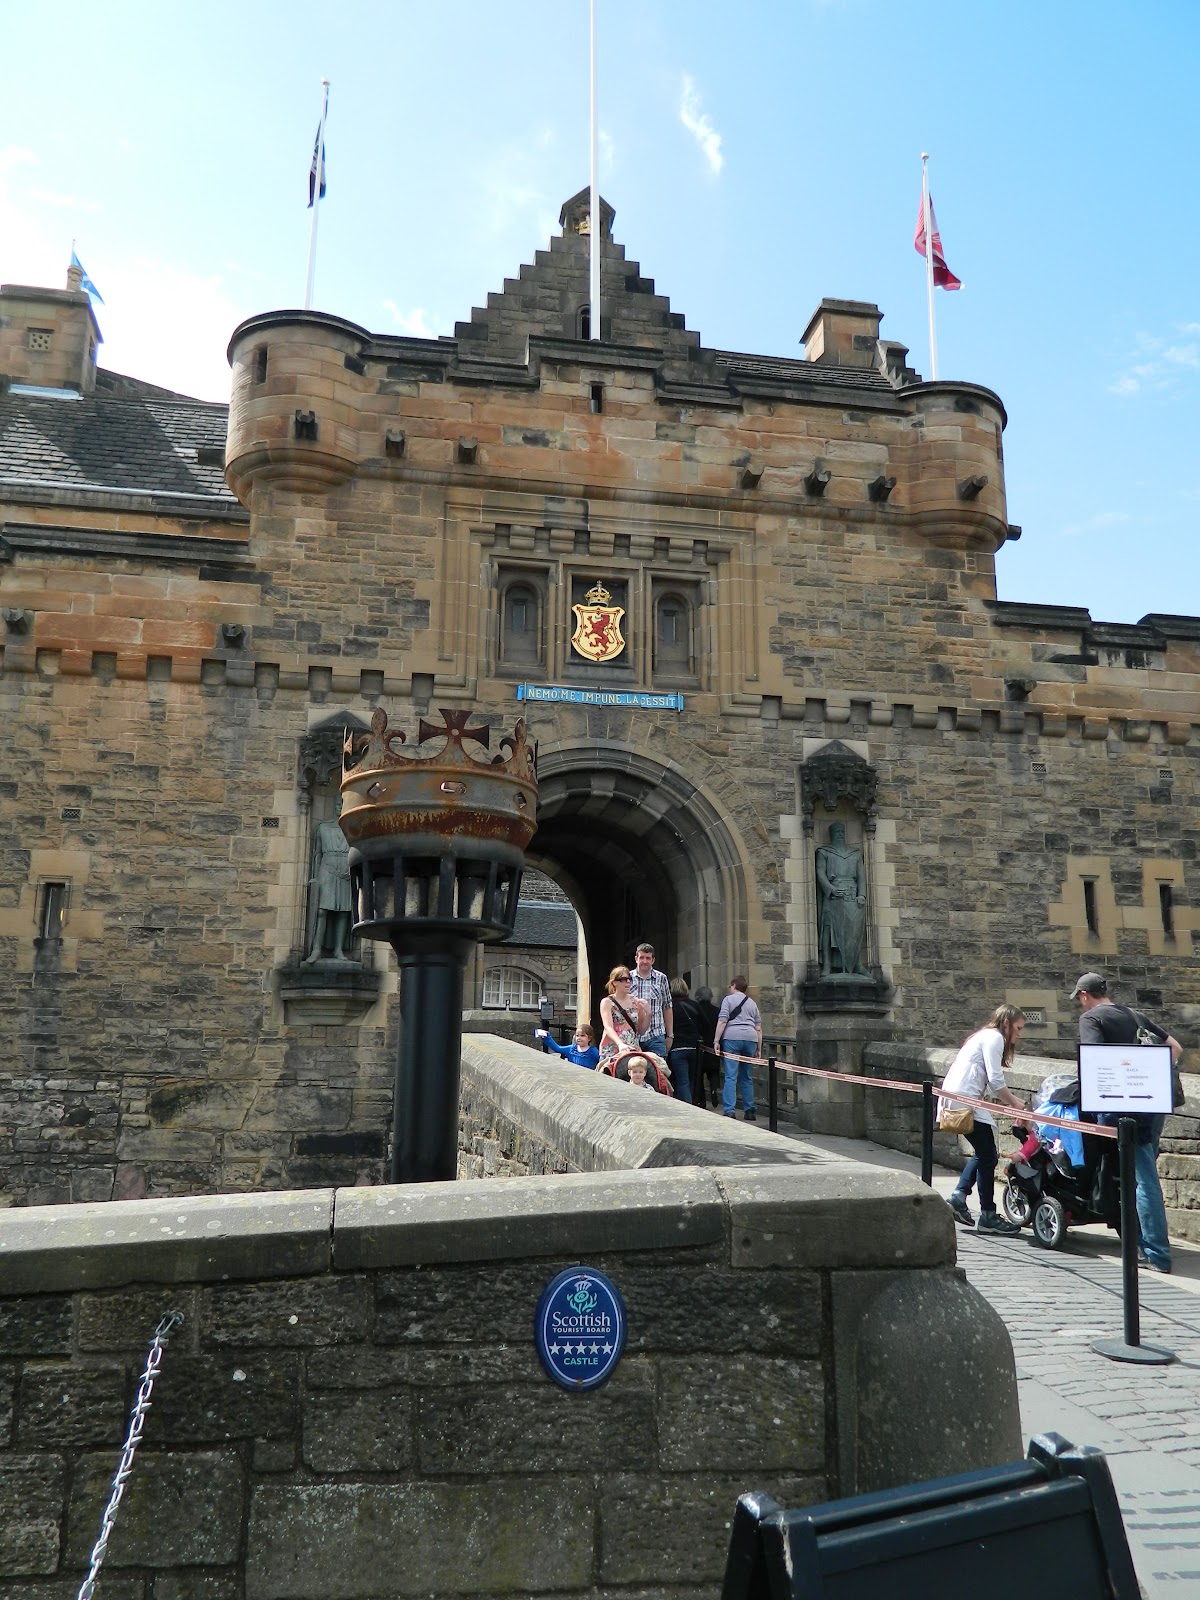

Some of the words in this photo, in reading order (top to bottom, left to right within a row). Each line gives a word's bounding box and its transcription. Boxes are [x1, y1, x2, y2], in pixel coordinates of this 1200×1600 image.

[528, 688, 558, 699] NEMO
[560, 690, 580, 701] ME
[581, 692, 622, 704] IMPUNE
[626, 696, 675, 707] LACESSIT
[551, 1311, 611, 1327] Scottish
[563, 1357, 599, 1365] CASTLE
